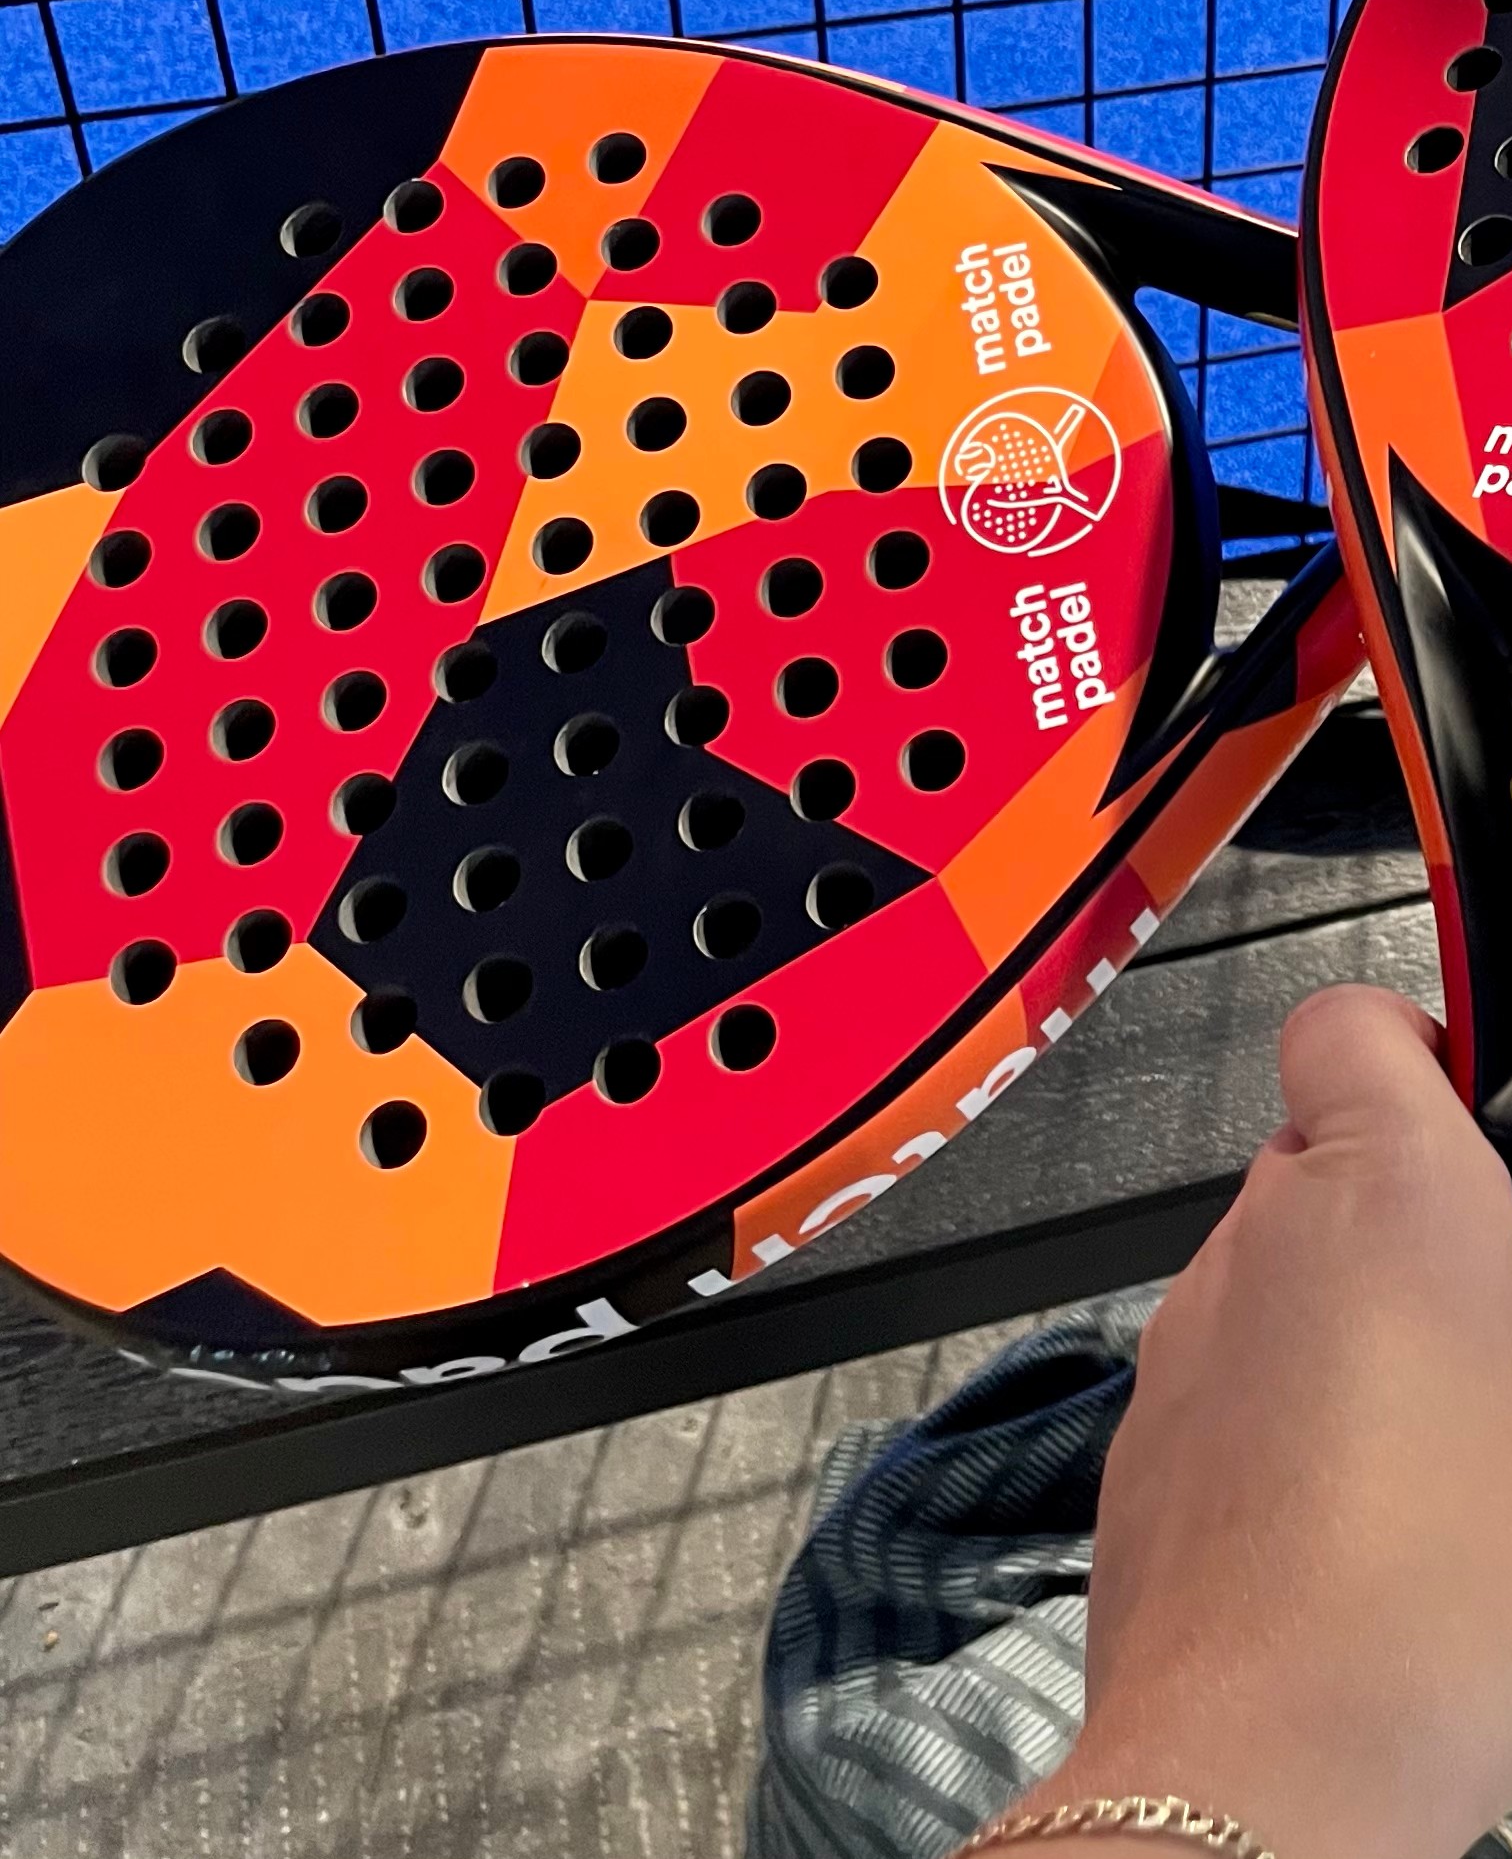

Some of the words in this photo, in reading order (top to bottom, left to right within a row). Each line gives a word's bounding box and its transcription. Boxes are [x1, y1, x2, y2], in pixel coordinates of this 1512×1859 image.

[955, 242, 1008, 375] match
[993, 241, 1052, 358] padel
[1009, 582, 1068, 731] match
[1049, 581, 1116, 712] padel
